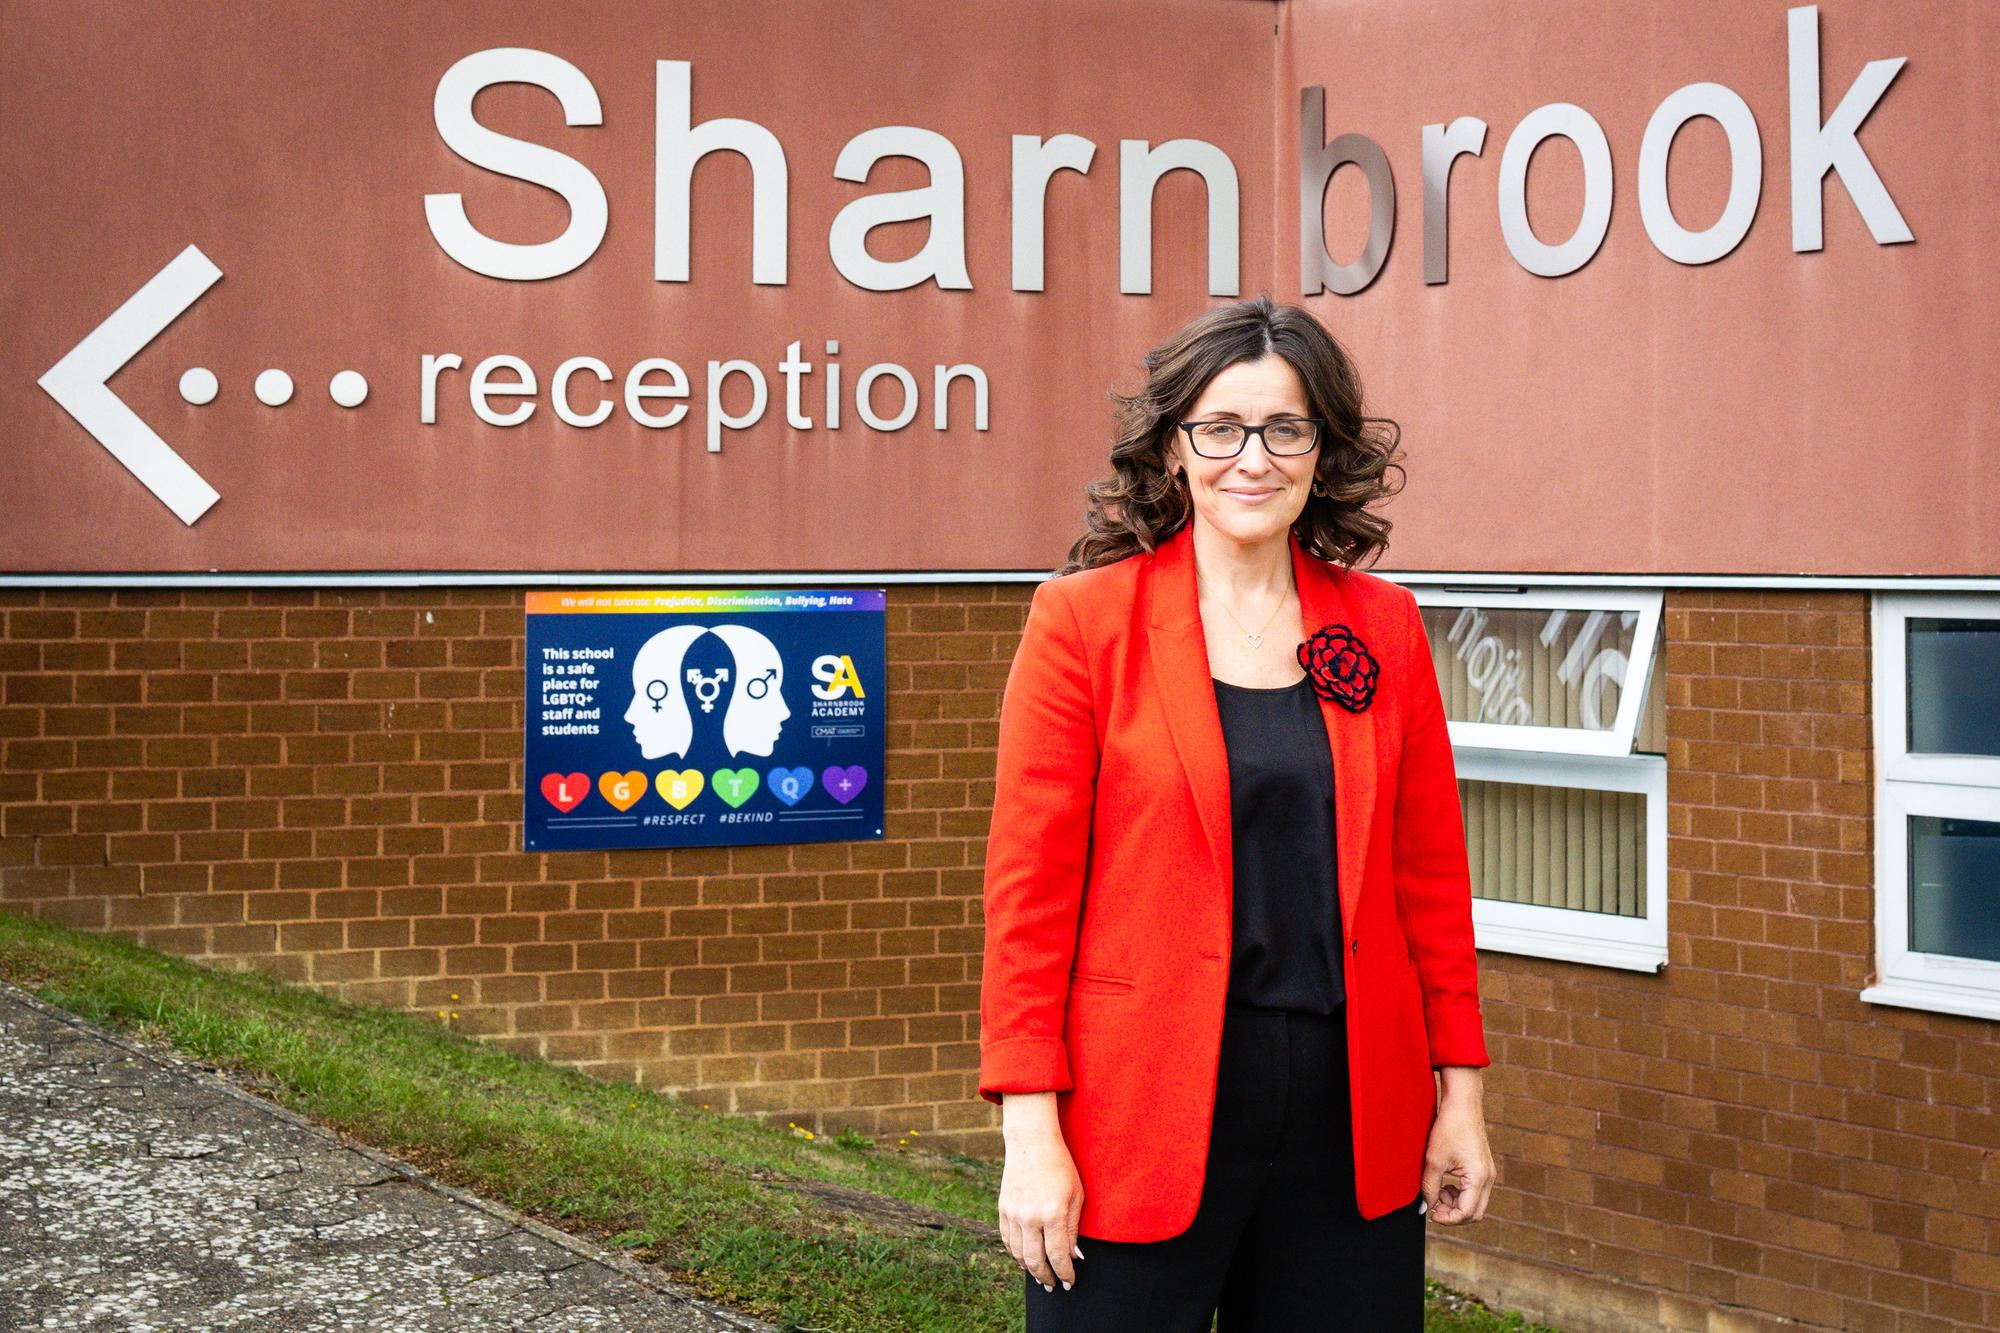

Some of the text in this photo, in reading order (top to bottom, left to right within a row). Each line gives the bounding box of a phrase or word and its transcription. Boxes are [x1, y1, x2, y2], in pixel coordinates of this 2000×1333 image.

[424, 6, 1915, 297] Sharnbrook
[421, 340, 989, 452] reception
[561, 597, 577, 607] We
[578, 597, 595, 607] will
[596, 597, 612, 607] not
[654, 596, 704, 608] Prejudice,
[707, 596, 782, 607] Discrimination,
[785, 595, 827, 607] Bullying,
[829, 596, 853, 606] Hate
[542, 647, 614, 660] This school
[542, 662, 595, 675] is a safe
[811, 654, 866, 701] SA
[542, 677, 600, 693] place for
[542, 693, 594, 707] LGBTQ+
[542, 707, 600, 720] staff and
[811, 707, 865, 717] ACADEMY
[542, 723, 600, 735] students
[558, 783, 572, 802] L
[613, 782, 630, 800] G
[672, 780, 687, 798] B
[729, 779, 743, 797] T
[781, 777, 799, 800] Q
[643, 811, 774, 826] #RESPECT #BEKIND
